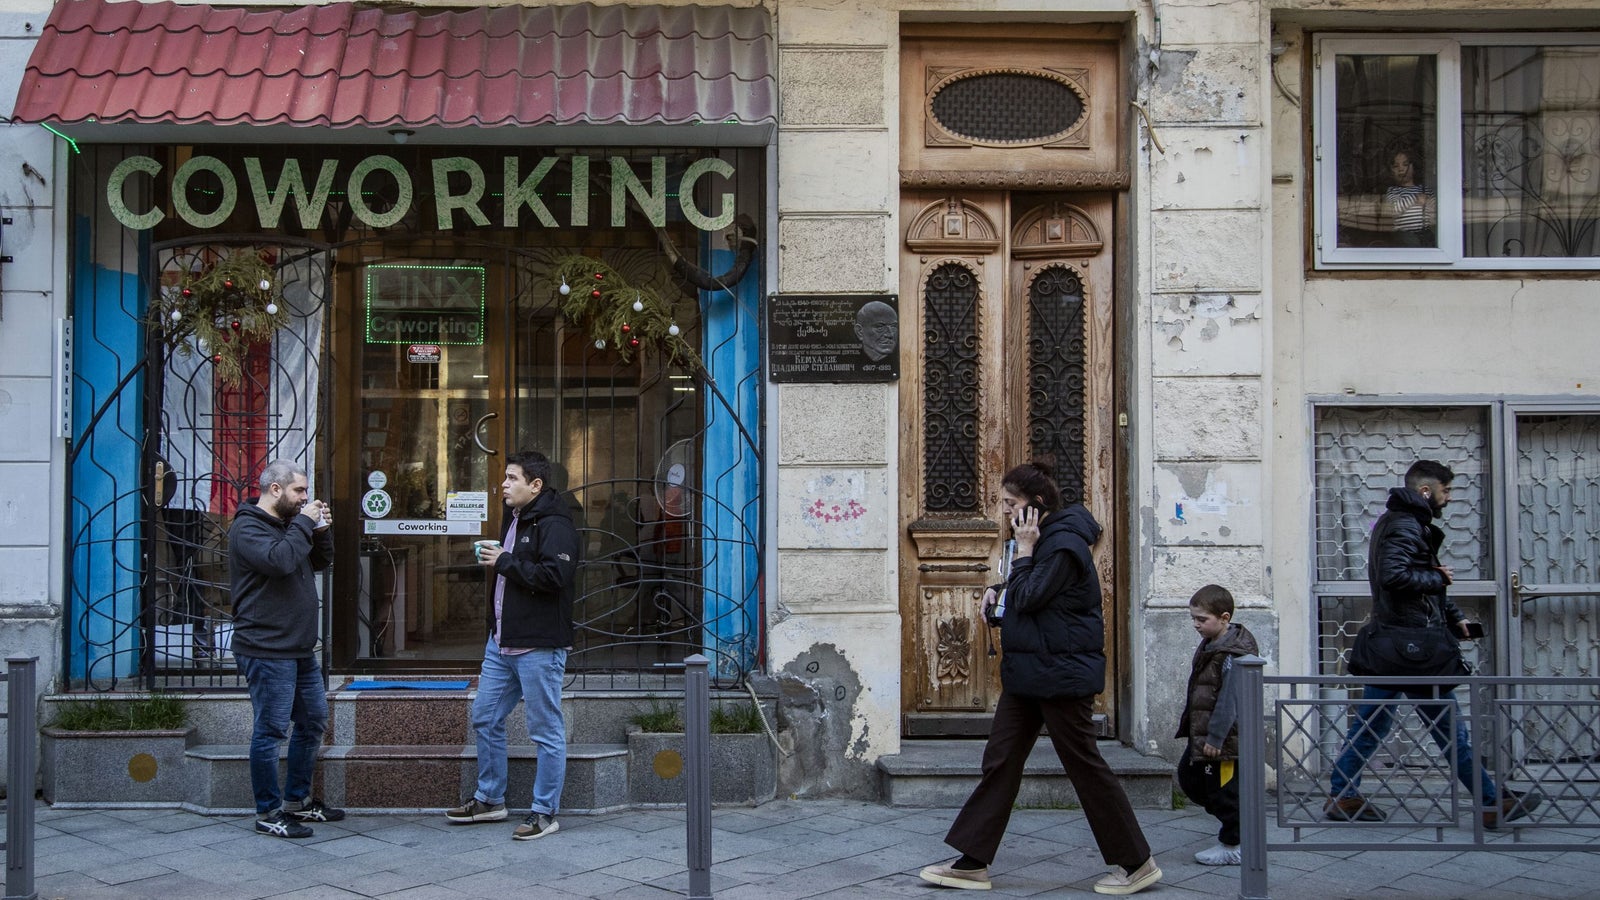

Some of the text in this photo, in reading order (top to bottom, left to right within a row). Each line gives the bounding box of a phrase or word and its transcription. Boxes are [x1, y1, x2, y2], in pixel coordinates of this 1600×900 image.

[107, 155, 736, 231] COWORKING
[373, 275, 479, 308] LINX
[371, 316, 480, 338] Coworking
[398, 522, 448, 533] Coworking
